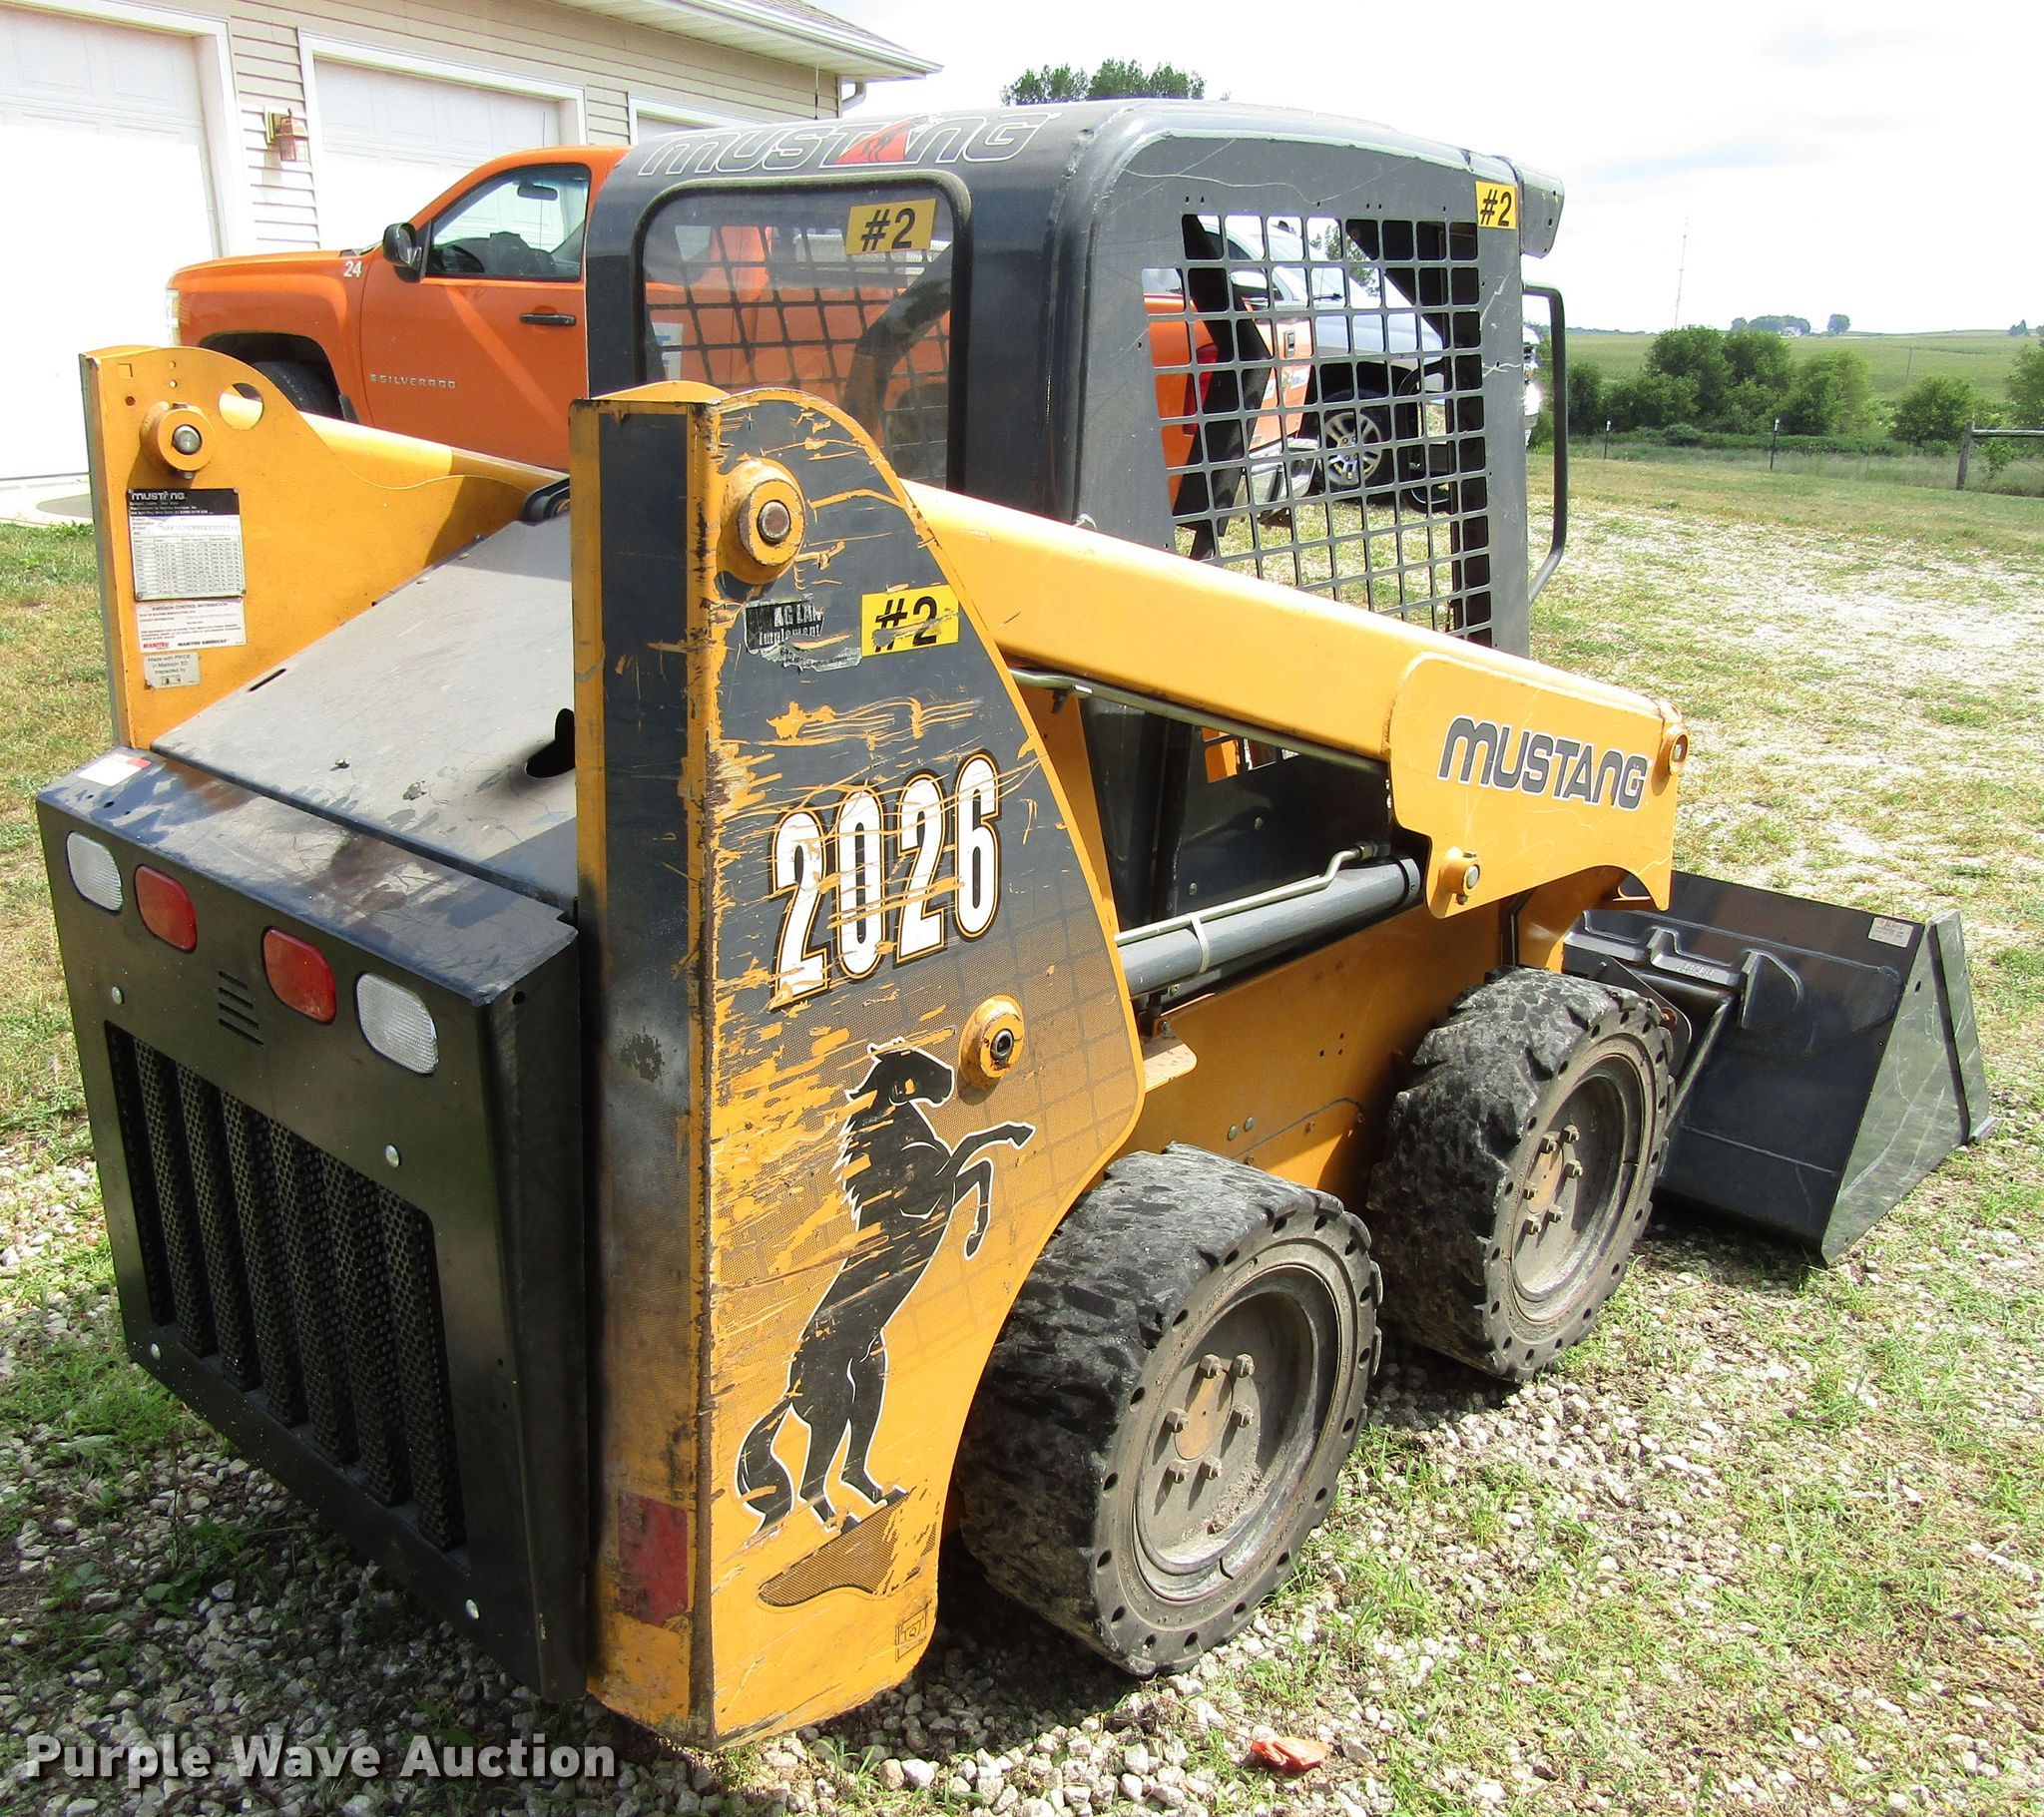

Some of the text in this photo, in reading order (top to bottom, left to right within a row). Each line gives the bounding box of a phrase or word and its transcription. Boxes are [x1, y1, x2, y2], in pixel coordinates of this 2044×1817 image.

[860, 208, 916, 251] #2
[1480, 189, 1513, 227] #2
[343, 260, 361, 277] 24
[379, 374, 456, 389] SILVERADO
[874, 596, 938, 654] #2
[1437, 714, 1649, 811] MUSTANG
[768, 749, 1003, 1012] 2026
